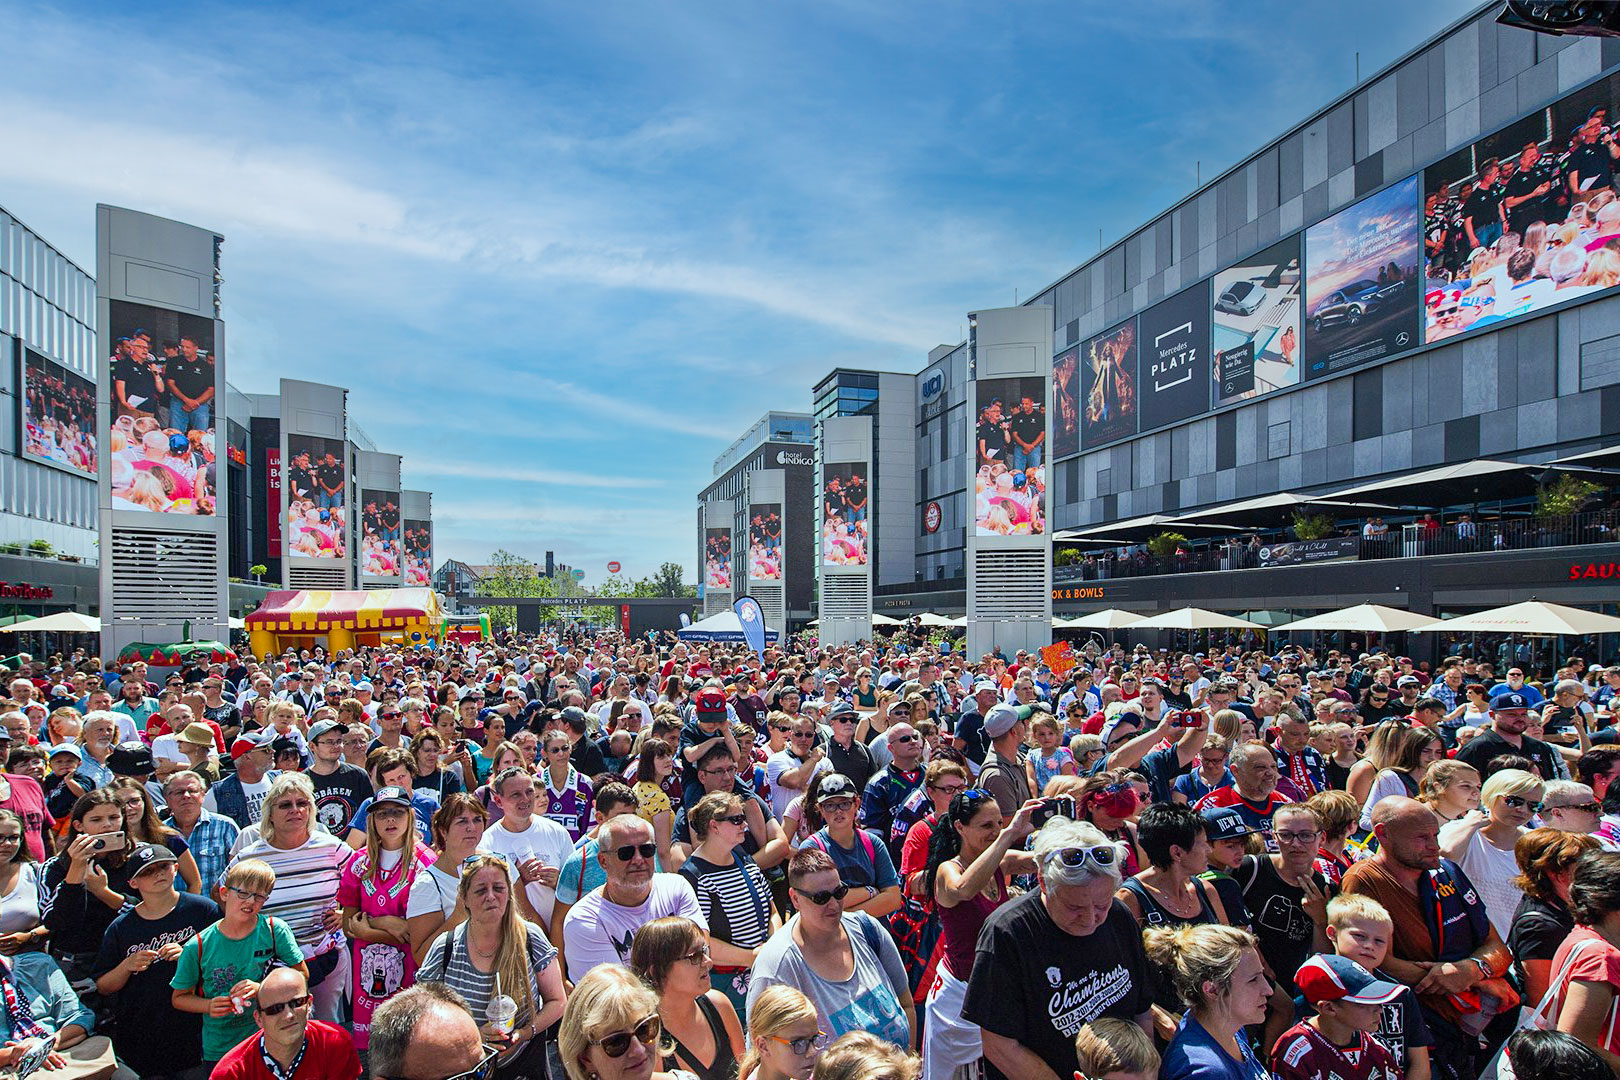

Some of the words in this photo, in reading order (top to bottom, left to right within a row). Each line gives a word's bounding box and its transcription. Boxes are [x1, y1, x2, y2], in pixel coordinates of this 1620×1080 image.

[1159, 341, 1188, 359] Mercedes
[1151, 348, 1196, 377] PLATZ
[785, 451, 802, 459] hotel
[785, 457, 814, 466] INDIGO
[1065, 589, 1072, 599] &
[1074, 587, 1104, 599] BOWLS
[1216, 815, 1236, 832] NEW
[1088, 969, 1099, 980] the
[1048, 963, 1124, 1018] Champions
